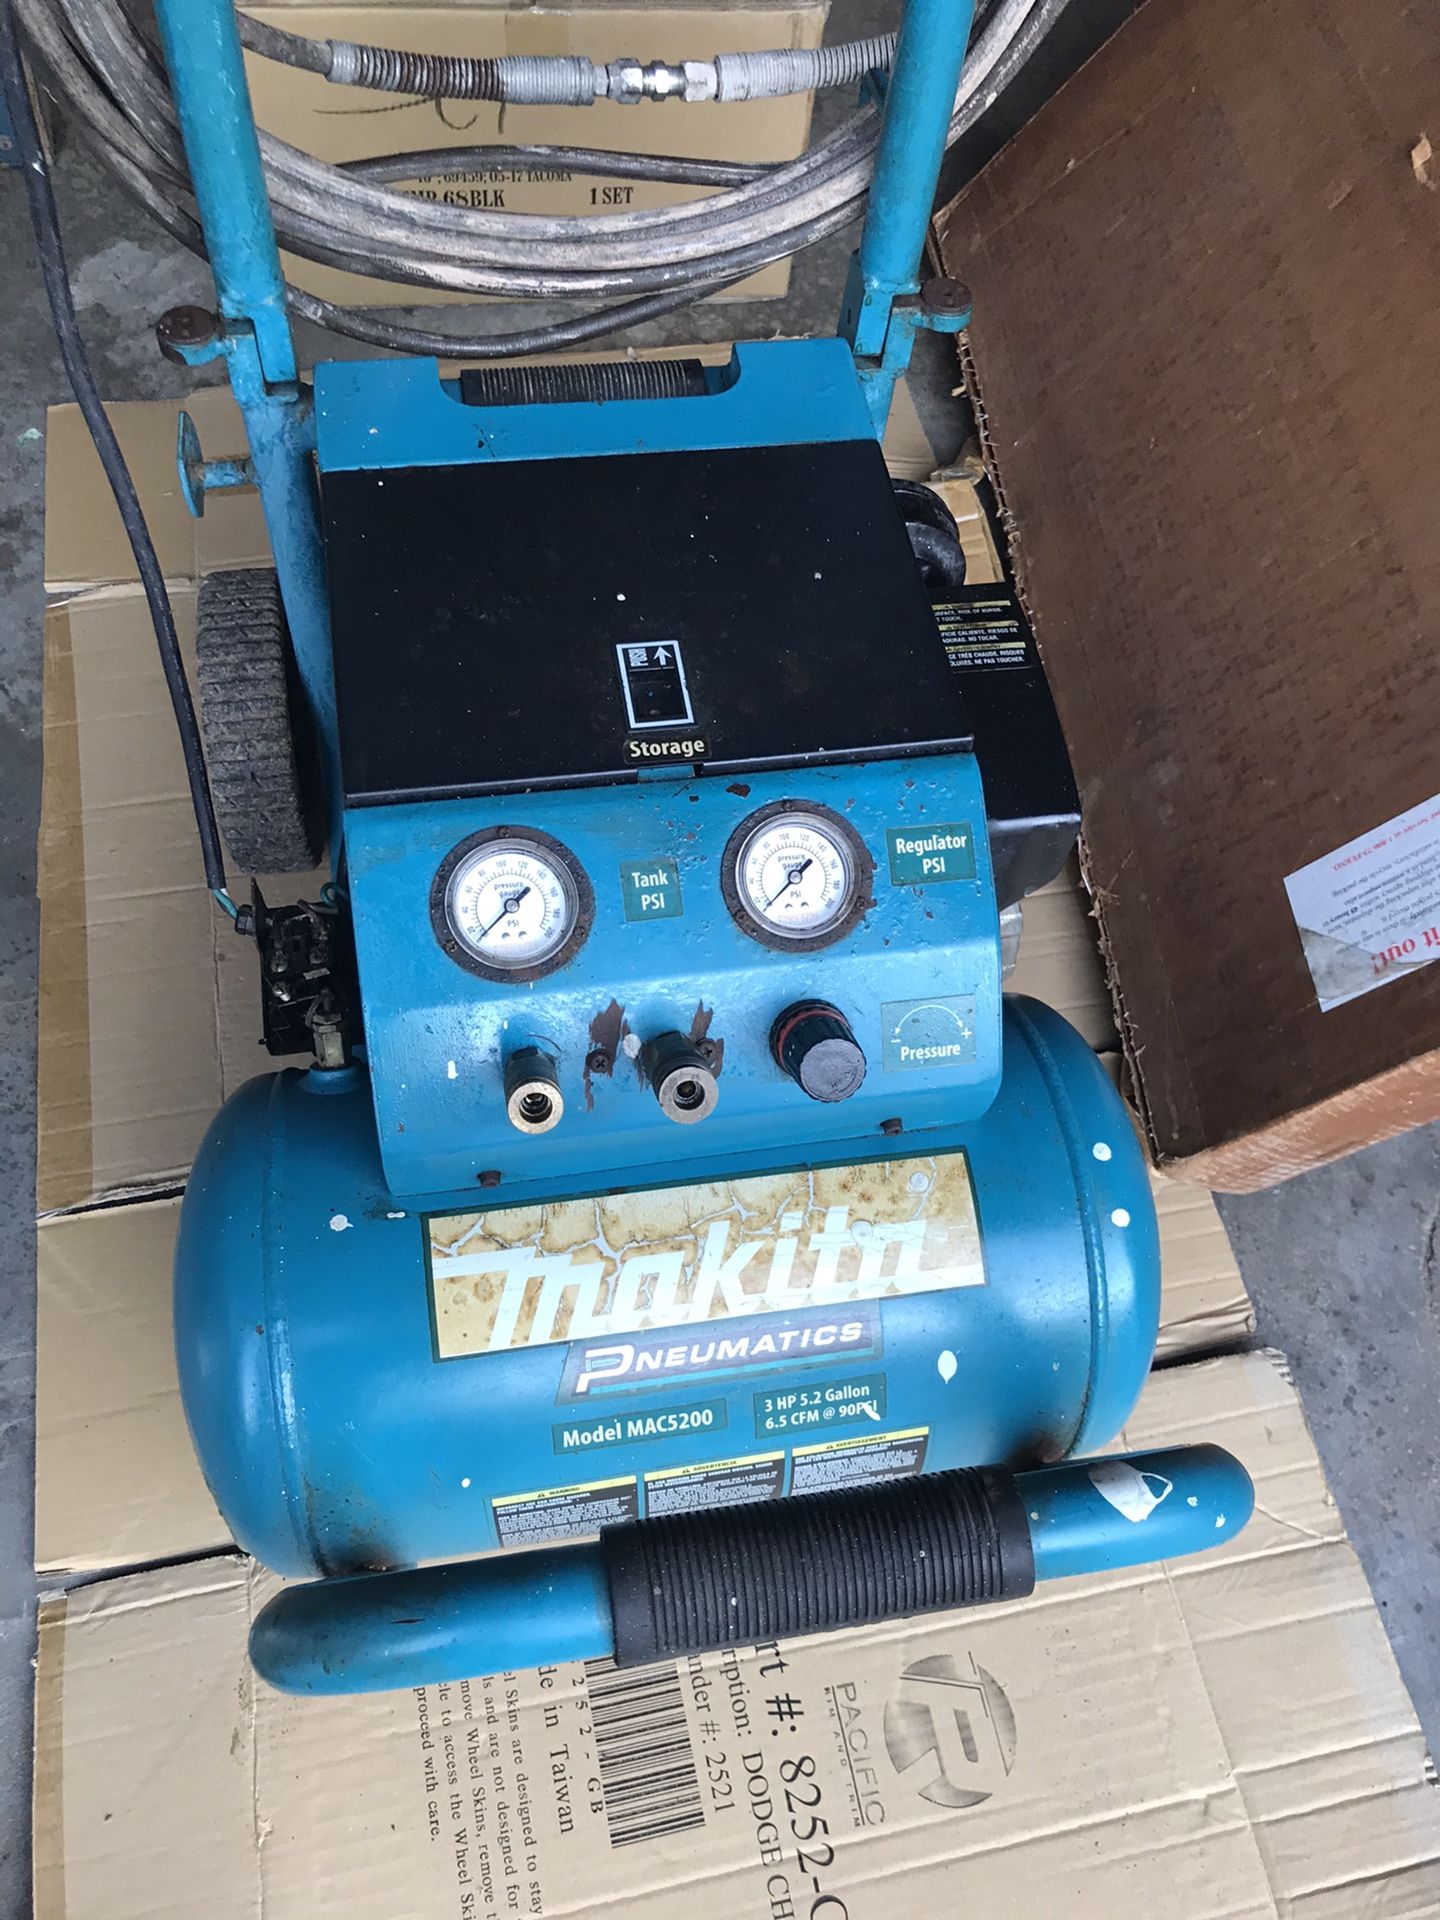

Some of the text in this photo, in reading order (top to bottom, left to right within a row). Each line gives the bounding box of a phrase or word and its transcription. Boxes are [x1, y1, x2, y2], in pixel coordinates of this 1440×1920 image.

[602, 186, 634, 205] SET
[629, 739, 705, 758] Storage
[777, 853, 806, 863] pressure
[895, 834, 967, 857] Regulator
[631, 869, 669, 889] Tank
[922, 857, 945, 874] PSI
[641, 892, 665, 911] PSI
[790, 890, 801, 899] PSI
[507, 918, 519, 928] PSI
[1419, 926, 1440, 950] it
[900, 1044, 961, 1061] Pressure
[575, 1321, 863, 1393] PNEUMATICS
[764, 1385, 870, 1413] 3 HP 5.2 Gallon
[562, 1408, 714, 1448] Model MAC5200
[765, 1417, 787, 1430] 6.5
[790, 1409, 820, 1425] CFM
[822, 1406, 836, 1420] @
[440, 1709, 453, 1727] to
[482, 1696, 499, 1724] and
[503, 1689, 523, 1732] Skins
[542, 1704, 564, 1728] in
[764, 1691, 806, 1735] #:
[462, 1727, 485, 1780] Wheel
[487, 1732, 500, 1758] are
[510, 1739, 524, 1764] are
[837, 1683, 884, 1824] PACIFIC
[412, 1686, 443, 1842] proceed with care.
[440, 1734, 460, 1785] access
[491, 1765, 506, 1793] not
[546, 1743, 581, 1835] Taiwan
[704, 1751, 736, 1814] 2521
[448, 1792, 465, 1820] the
[468, 1785, 492, 1837] Skins,
[510, 1771, 539, 1847] designed
[738, 1752, 785, 1865] DODGE
[491, 1800, 520, 1876] designed
[449, 1827, 474, 1886] Wheel
[525, 1854, 538, 1872] to
[475, 1843, 496, 1904] remove
[505, 1883, 523, 1910] for
[524, 1880, 545, 1915] stay
